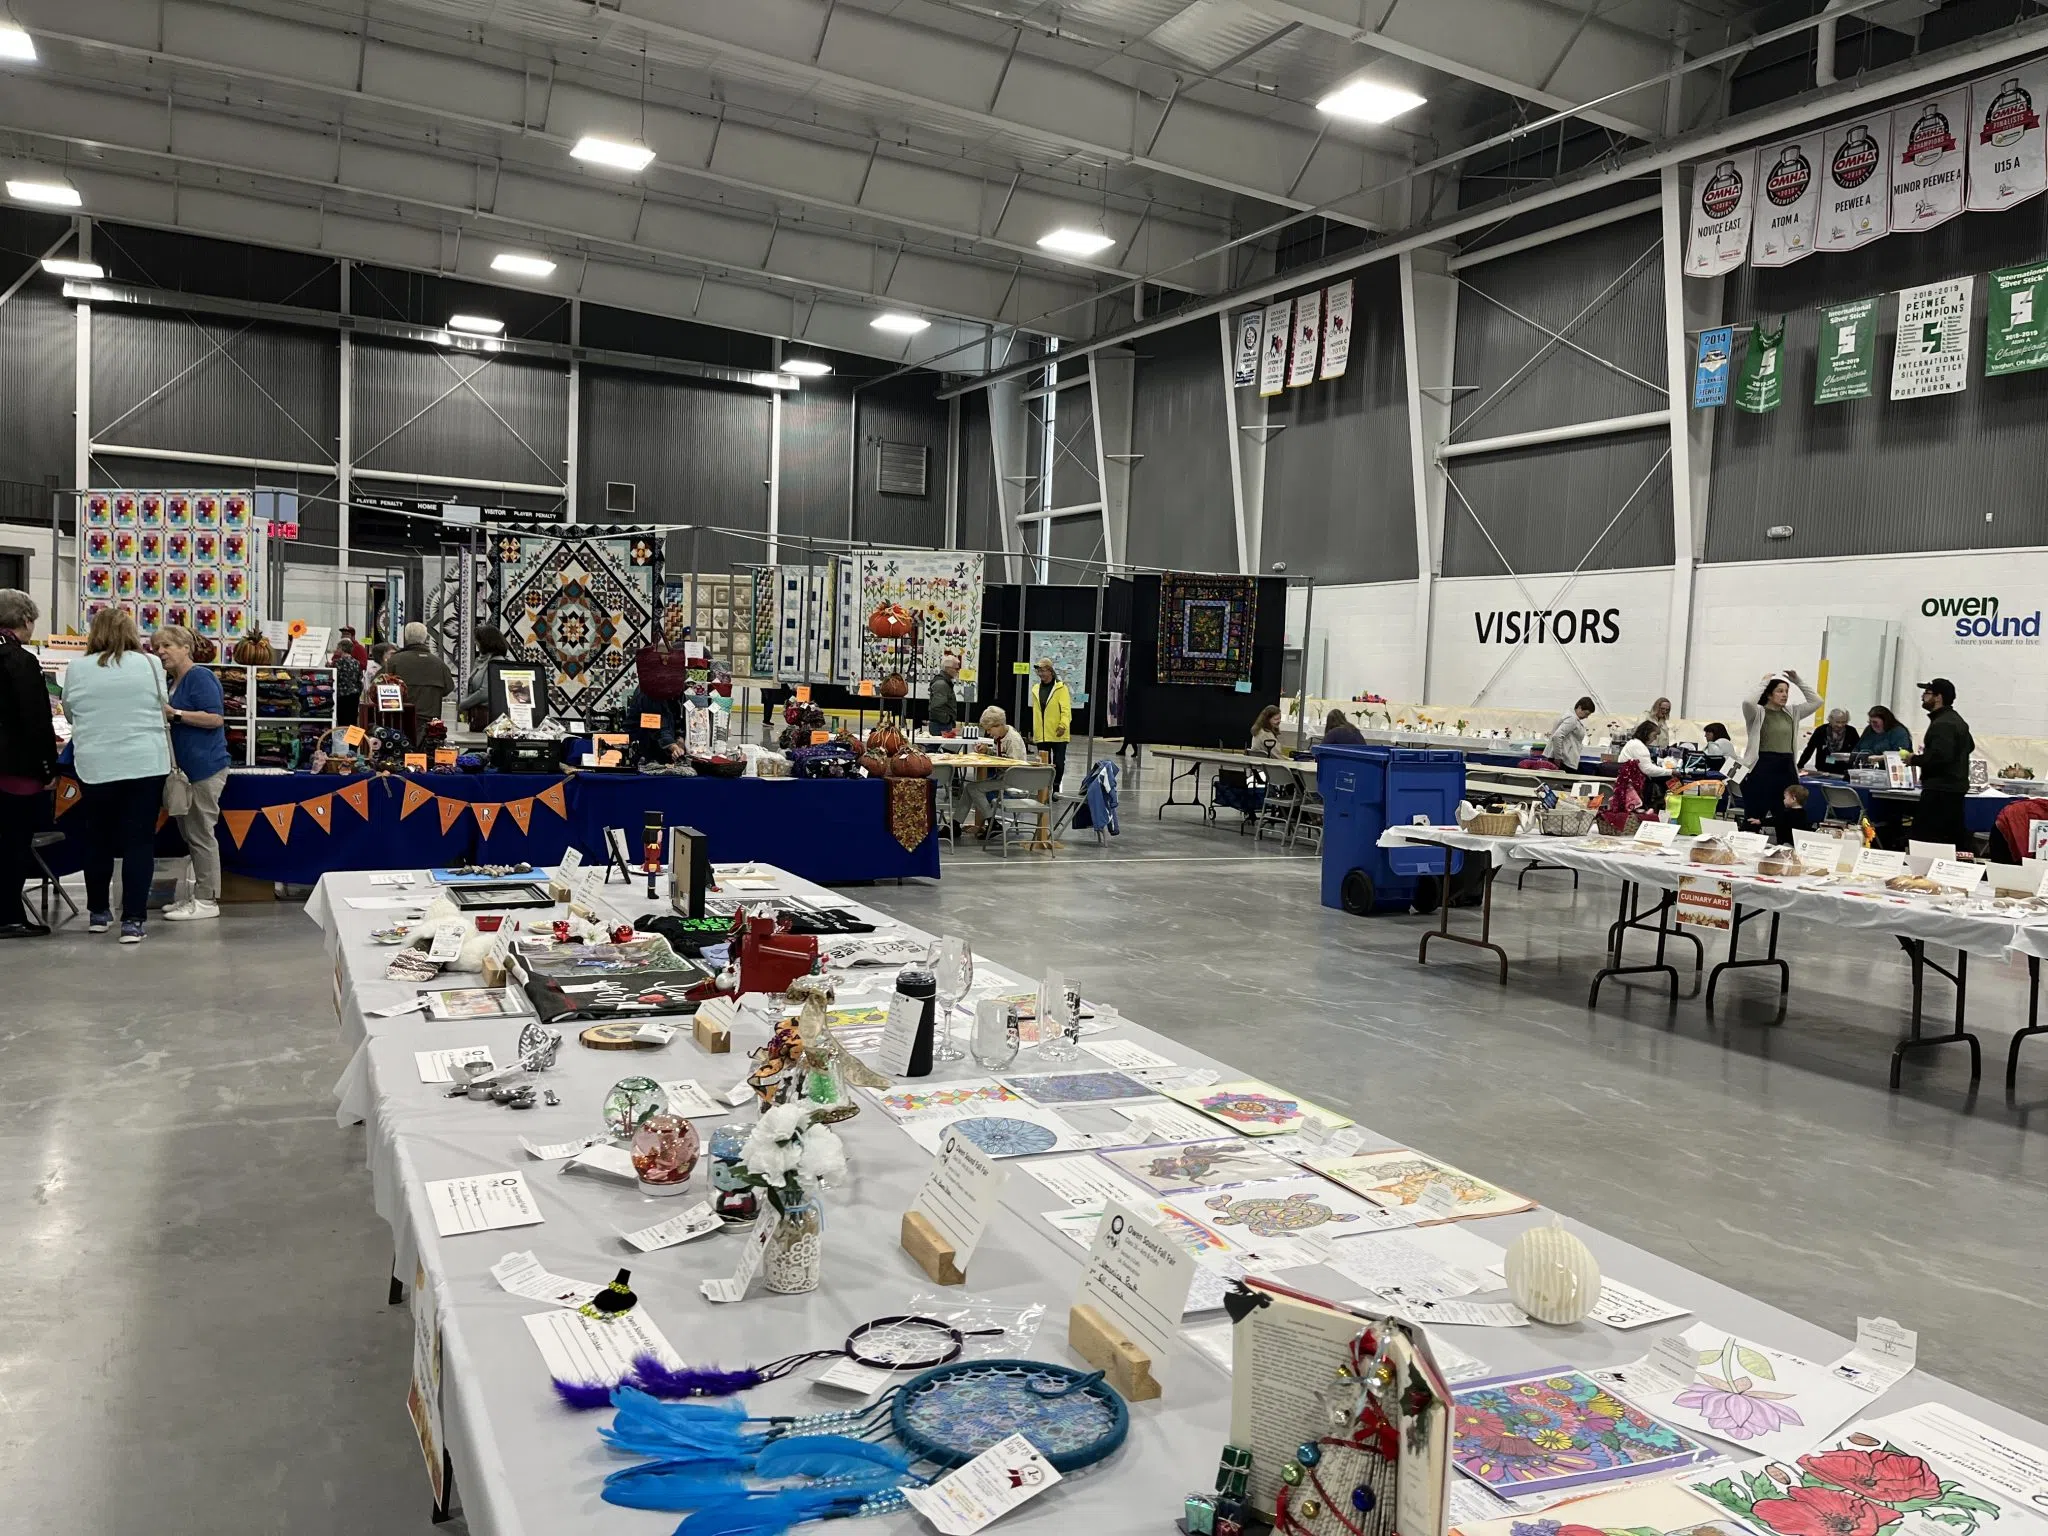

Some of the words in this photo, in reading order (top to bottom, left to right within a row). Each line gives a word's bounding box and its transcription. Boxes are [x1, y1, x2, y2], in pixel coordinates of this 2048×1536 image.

[1992, 102, 2026, 120] OMHA
[1914, 128, 1944, 141] OMHA
[1834, 151, 1876, 172] OMHA
[1994, 159, 2012, 174] U15
[2014, 157, 2020, 168] A
[1769, 170, 1808, 189] OMHA
[1894, 179, 1920, 196] MINOR
[1923, 172, 1954, 188] PEEWEE
[1956, 169, 1961, 180] A
[1705, 185, 1740, 202] OMHA
[1835, 196, 1864, 213] PEEWEE
[1866, 195, 1870, 205] A
[1698, 222, 1722, 238] NOVICE
[1725, 218, 1741, 232] EAST
[1772, 216, 1792, 229] ATOM
[1794, 213, 1799, 223] A
[1716, 234, 1720, 245] A
[1998, 266, 2048, 282] International
[2000, 278, 2022, 289] Silver
[2023, 275, 2043, 284] Stick
[1914, 285, 1959, 299] 2018-2019
[1906, 296, 1946, 311] PEEWEE
[1960, 293, 1964, 301] A
[1828, 304, 1871, 318] International
[1905, 304, 1964, 322] CHAMPIONS
[1830, 316, 1848, 324] Silver
[1704, 333, 1726, 346] 2014
[1995, 341, 2047, 360] Champions
[1899, 354, 1964, 370] INTERNATIONAL
[1823, 370, 1867, 386] Champions
[1901, 368, 1931, 378] SILVER
[1936, 364, 1961, 373] STICK
[1916, 375, 1944, 385] FINALS
[1921, 597, 1999, 618] owen
[1475, 608, 1620, 644] VISITORS
[1955, 610, 2041, 637] sound
[408, 789, 560, 822] GIRLS
[1680, 893, 1712, 903] CULINARY
[1713, 898, 1729, 907] ARTS
[1128, 1225, 1143, 1241] Owen
[1142, 1236, 1158, 1253] Sound
[1157, 1246, 1168, 1260] Fall
[1167, 1254, 1176, 1266] Fair
[626, 1315, 637, 1328] Owen
[635, 1326, 646, 1341] Sound
[1010, 1436, 1032, 1457] Entry
[1912, 1440, 1932, 1451] Fair
[1933, 1449, 1952, 1460] Fall
[1953, 1459, 1988, 1477] Sound
[1989, 1476, 2022, 1493] Owen
